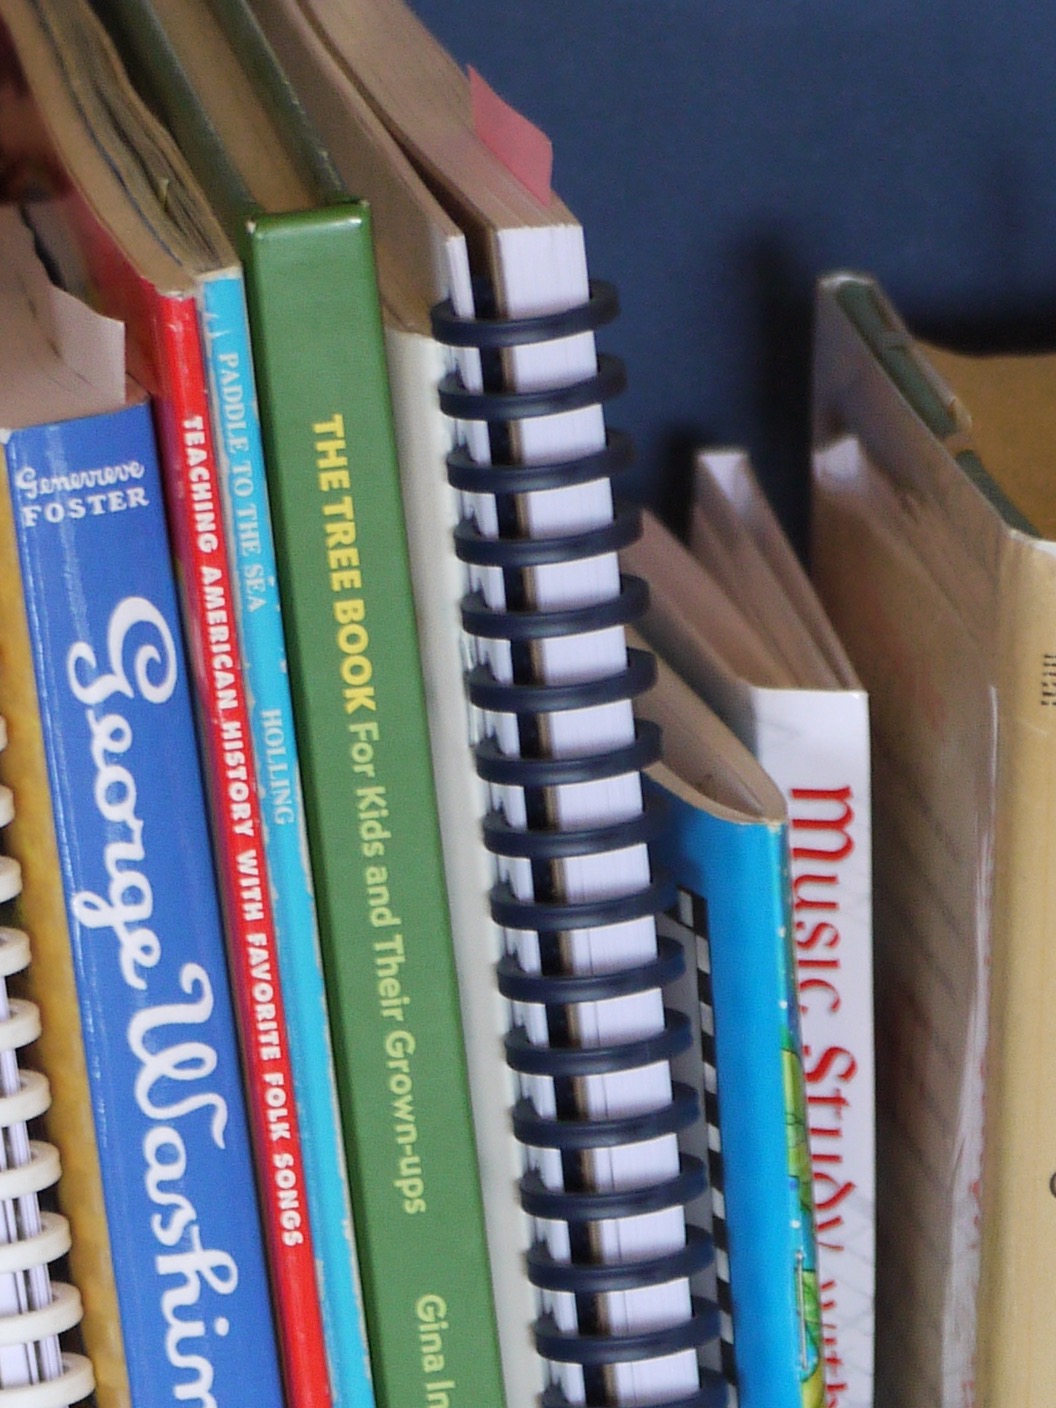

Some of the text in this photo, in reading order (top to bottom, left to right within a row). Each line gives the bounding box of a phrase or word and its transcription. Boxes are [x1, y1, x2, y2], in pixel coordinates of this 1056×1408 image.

[15, 460, 146, 499] Genevieve
[22, 486, 149, 528] FOSTER
[217, 352, 267, 613] PADDLE TO THE SEA
[66, 596, 177, 991] George
[183, 415, 304, 1247] TEACHING AMERICAN HISTORY WITH FAVORITE FOLK SONGS
[261, 707, 294, 826] HOLLING
[312, 413, 427, 1215] THE TREE BOOK For Kids and Their Grown-ups
[415, 1293, 449, 1374] Gina
